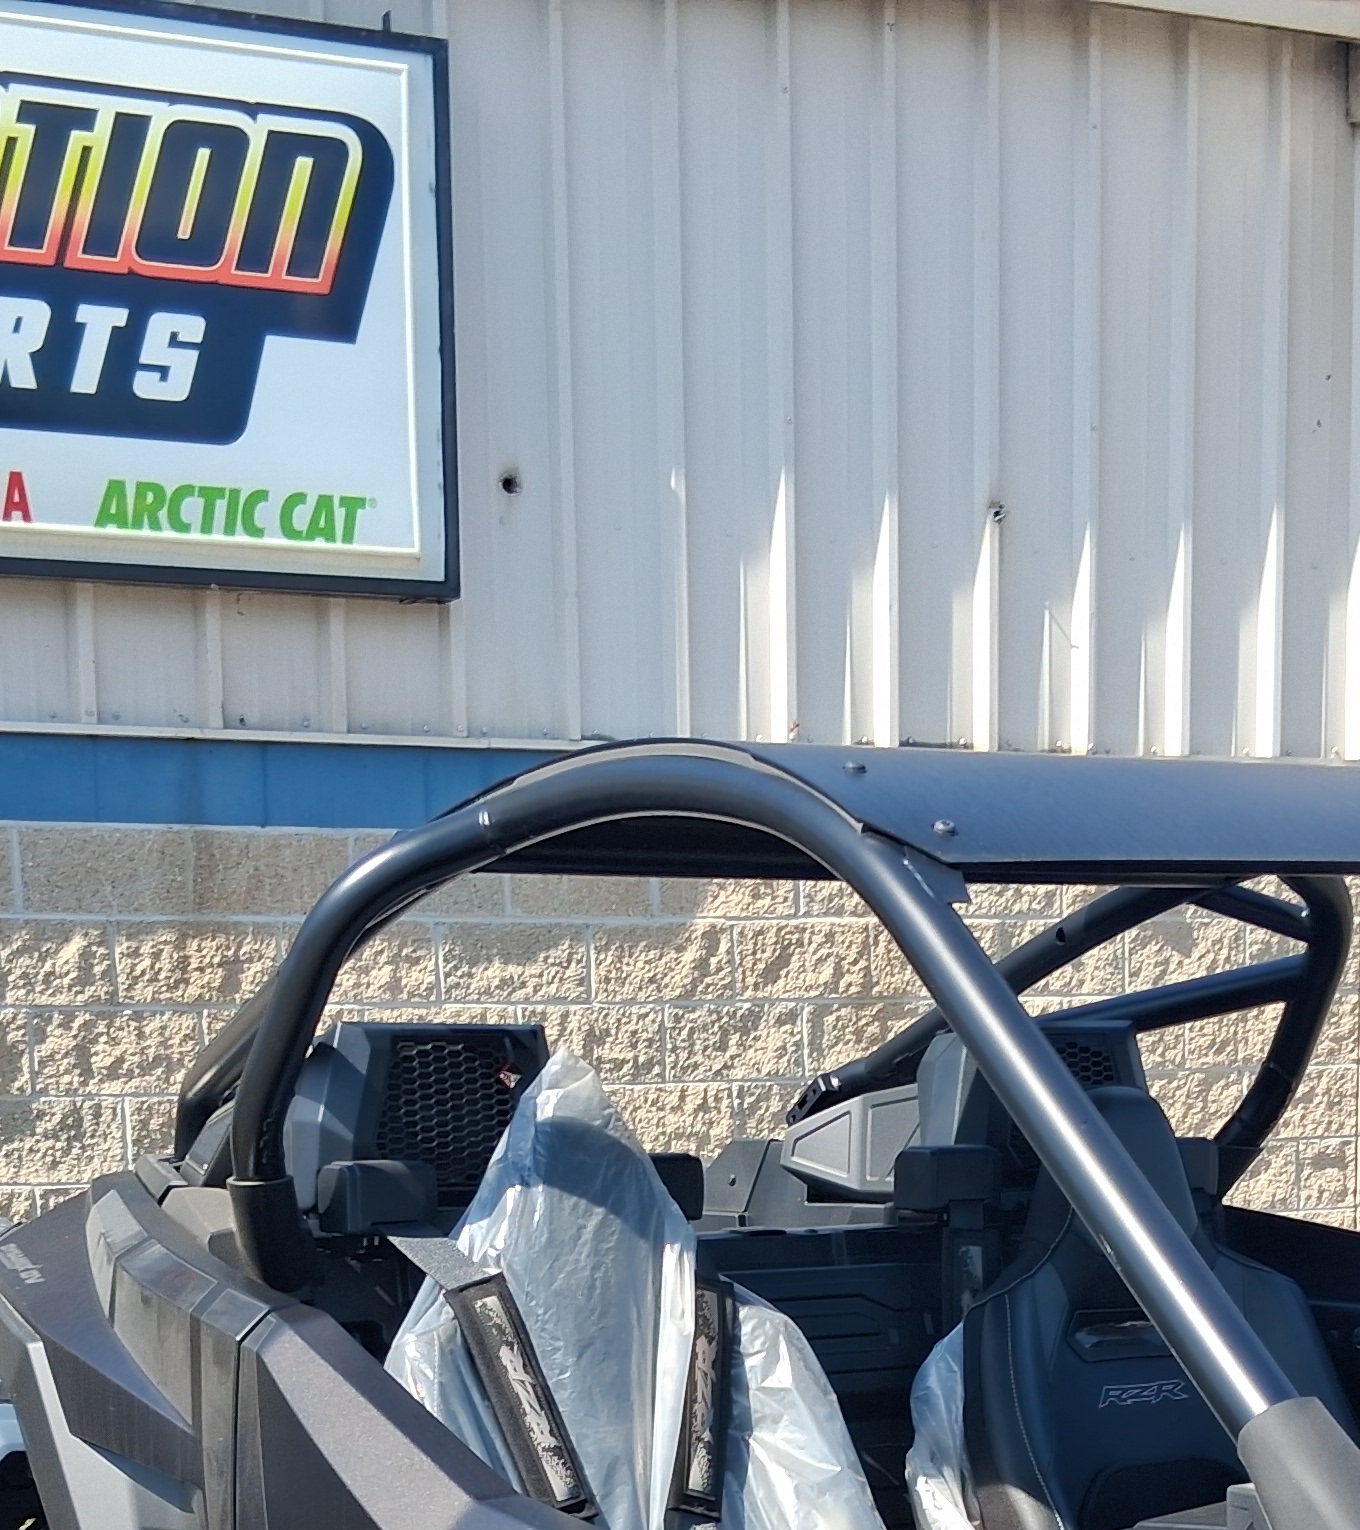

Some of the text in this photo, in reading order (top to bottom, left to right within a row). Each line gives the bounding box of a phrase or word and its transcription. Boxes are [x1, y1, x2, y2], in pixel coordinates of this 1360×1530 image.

[95, 478, 369, 546] ARCTIC CAT
[1098, 1379, 1190, 1409] RZR
